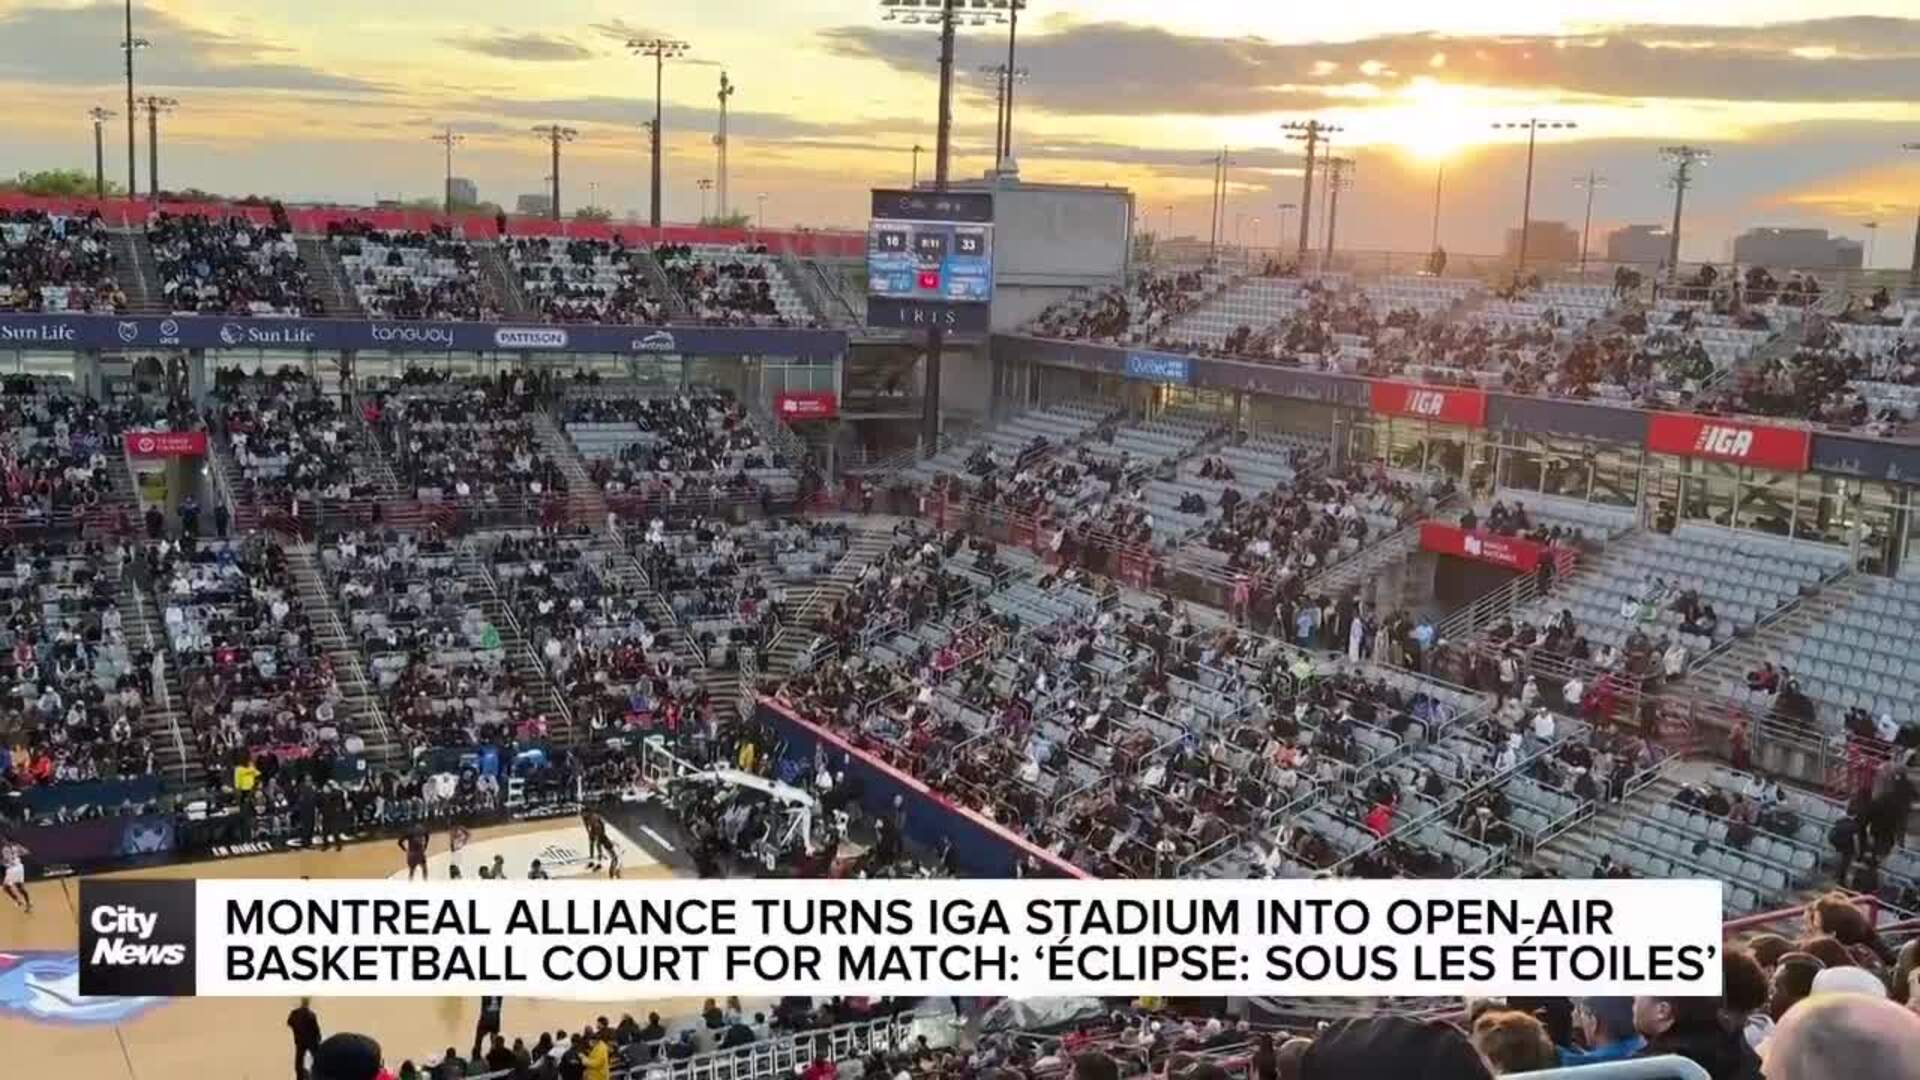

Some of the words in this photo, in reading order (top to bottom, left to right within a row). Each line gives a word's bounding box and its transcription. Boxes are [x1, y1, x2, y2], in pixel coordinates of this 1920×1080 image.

[961, 239, 976, 251] 33
[900, 308, 956, 324] IRIS
[1, 324, 37, 340] Sun
[42, 323, 75, 340] Life
[249, 327, 280, 342] Sun
[284, 327, 315, 342] Life
[500, 332, 562, 344] PATTISON
[1411, 390, 1444, 415] IGA
[1704, 425, 1753, 456] IGA
[230, 841, 272, 855] DIRECT
